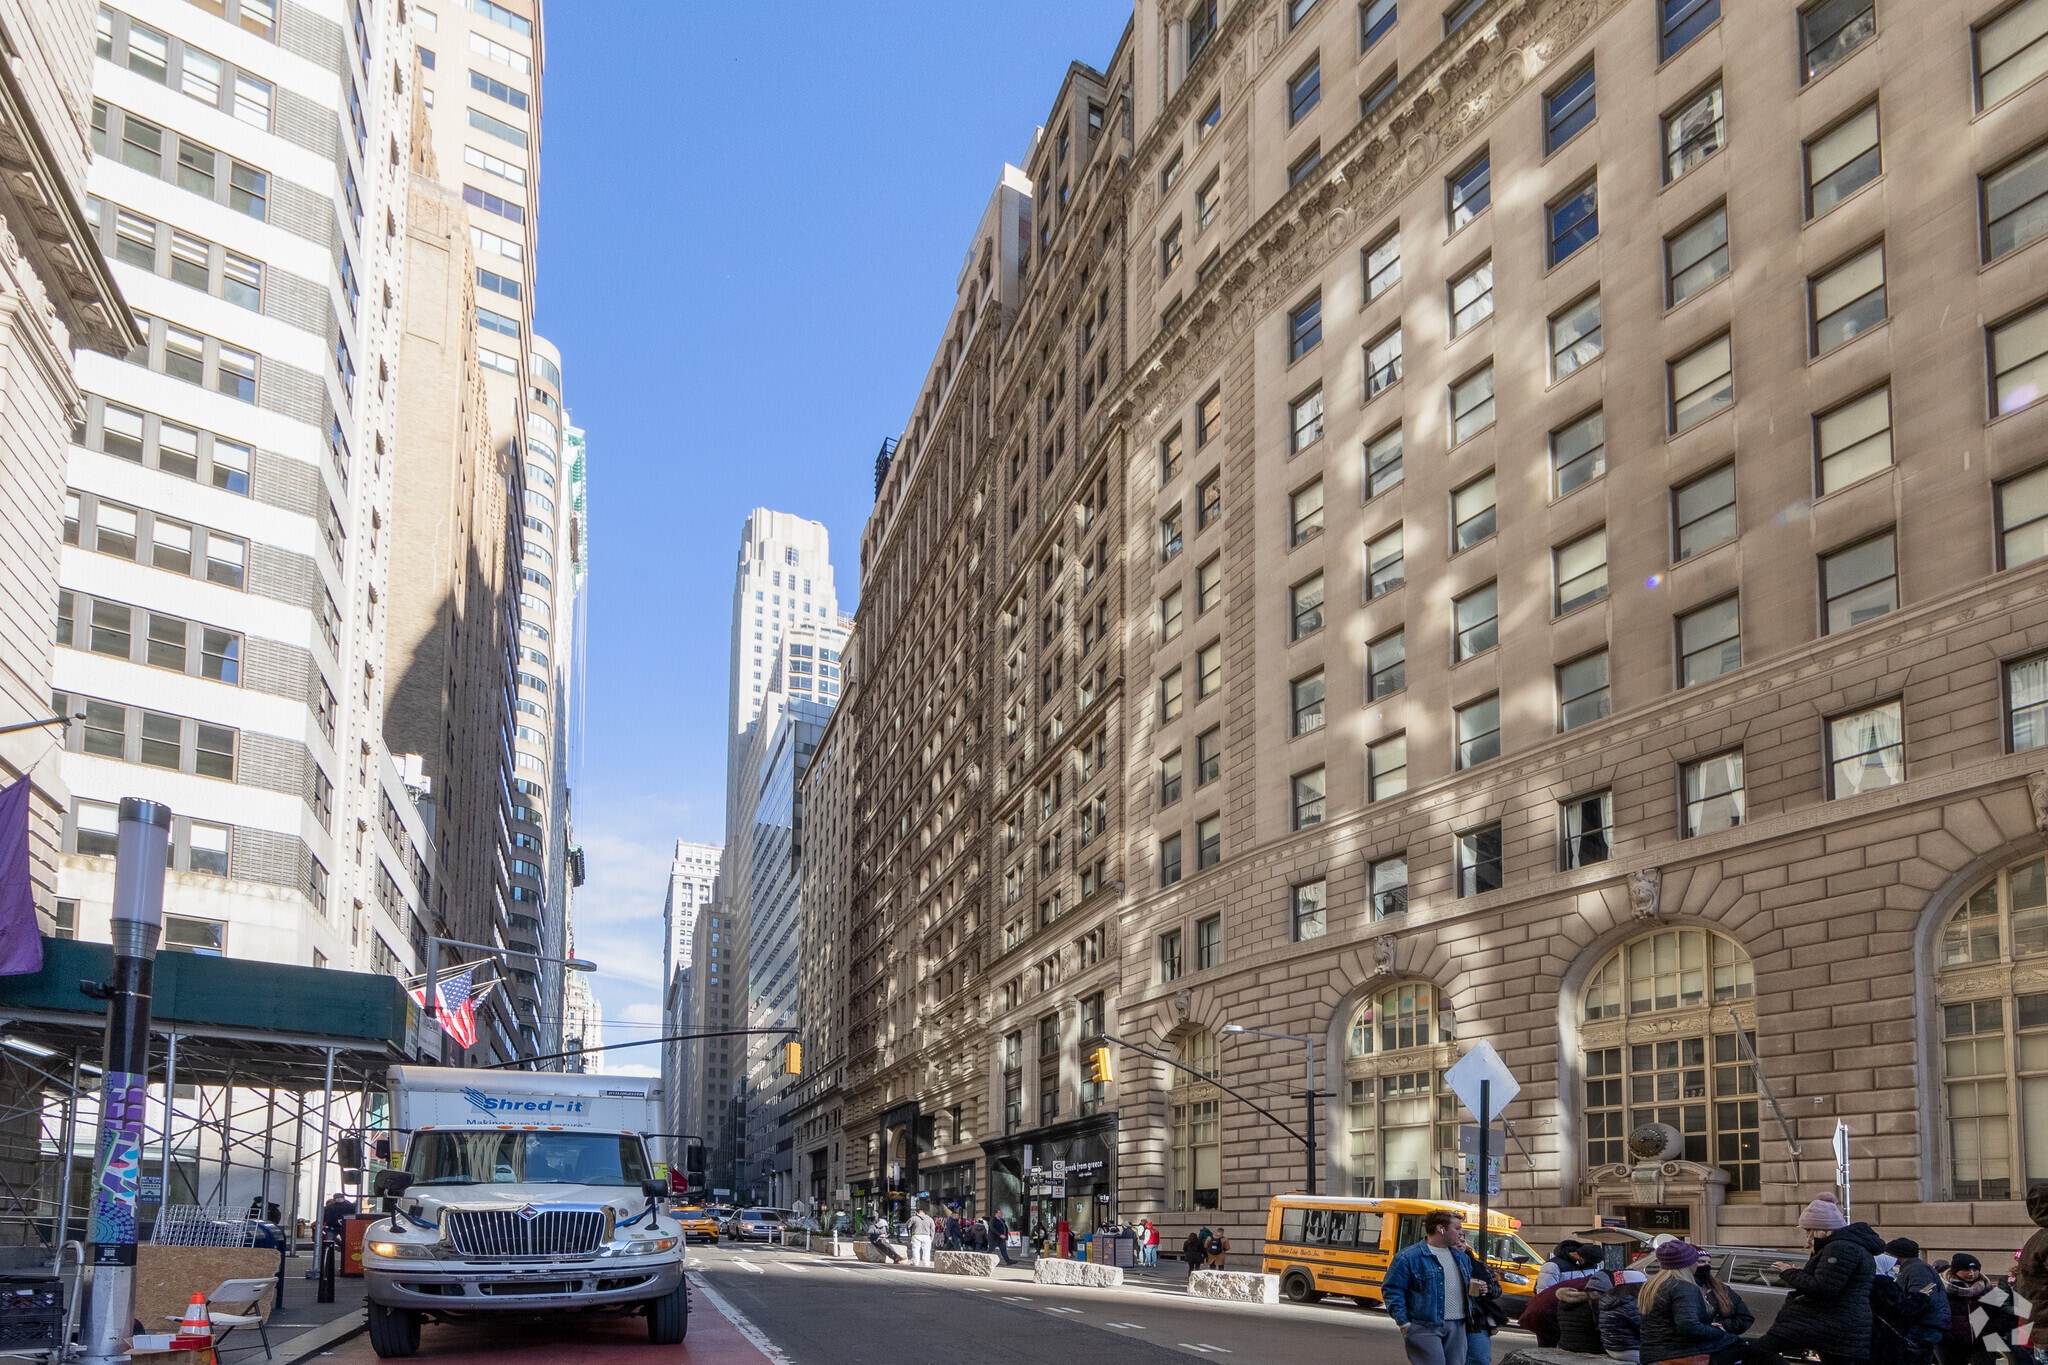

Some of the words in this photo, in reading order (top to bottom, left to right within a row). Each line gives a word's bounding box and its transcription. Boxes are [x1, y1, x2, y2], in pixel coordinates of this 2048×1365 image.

[483, 1097, 583, 1112] Shred-it
[1077, 1162, 1087, 1172] from
[1087, 1161, 1103, 1171] greece
[1472, 1214, 1496, 1226] SOL
[1497, 1216, 1506, 1228] BUS
[1655, 1215, 1669, 1224] 28
